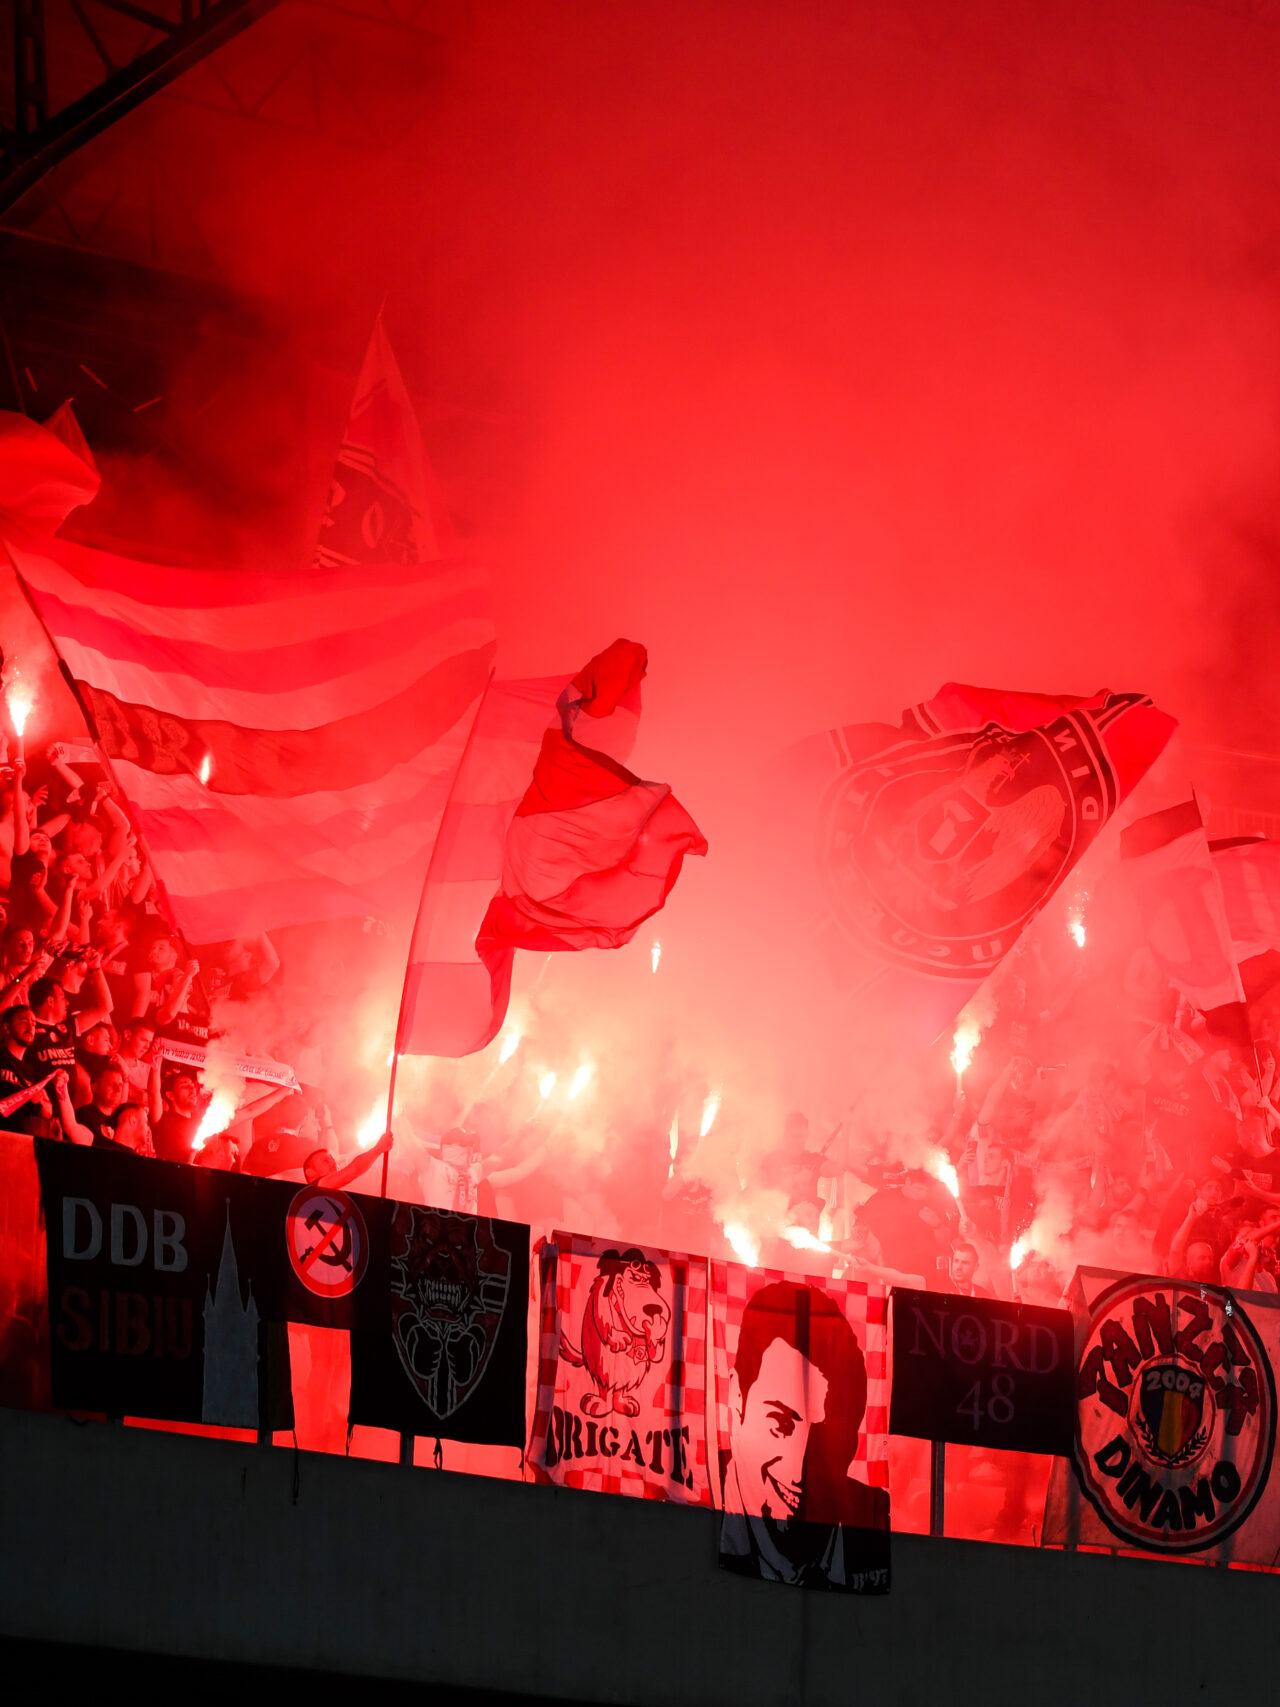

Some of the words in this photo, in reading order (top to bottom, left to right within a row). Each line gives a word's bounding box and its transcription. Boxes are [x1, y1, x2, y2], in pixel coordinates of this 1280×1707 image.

[62, 1196, 189, 1273] DDB
[57, 1283, 193, 1360] SIBIU
[907, 1306, 1061, 1375] NORD
[954, 1372, 1016, 1432] 48
[1094, 1434, 1241, 1531] DINAMO
